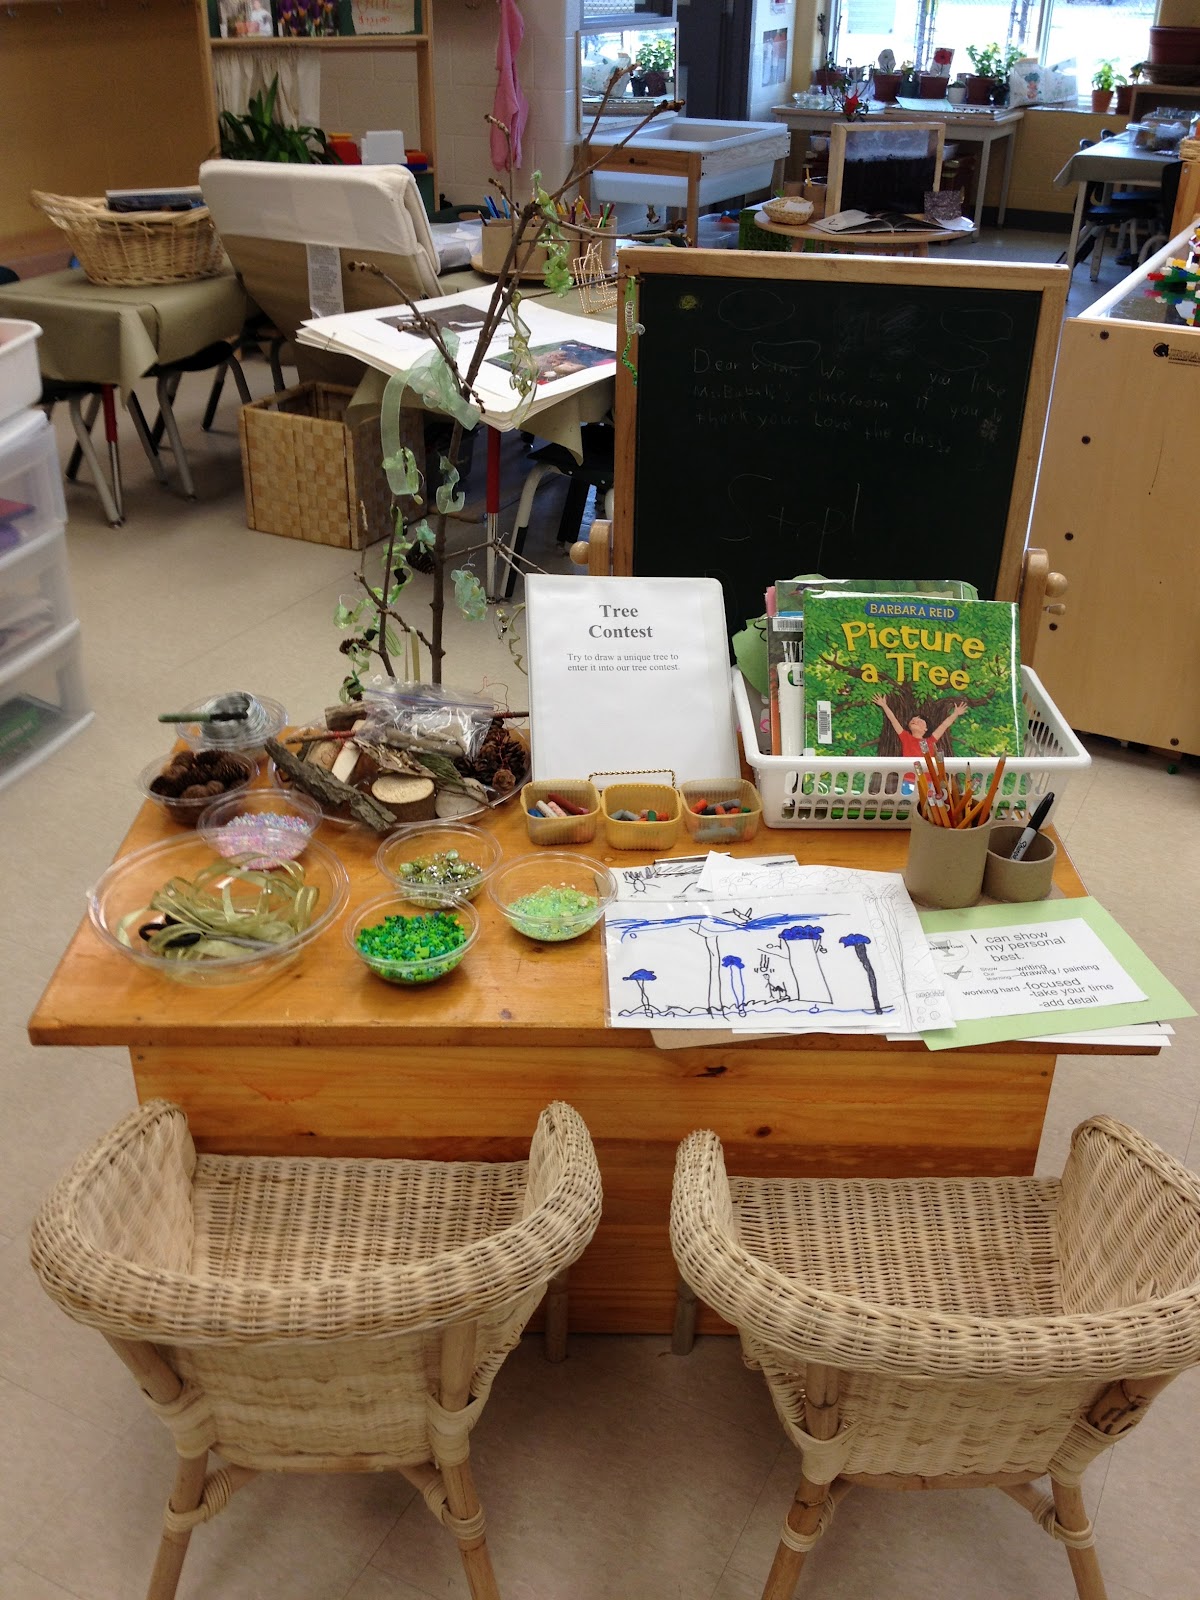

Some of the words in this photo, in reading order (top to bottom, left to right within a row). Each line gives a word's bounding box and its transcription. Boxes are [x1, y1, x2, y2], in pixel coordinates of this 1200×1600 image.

[693, 348, 740, 373] Dear
[808, 387, 889, 409] classroom
[950, 406, 980, 421] you
[864, 416, 891, 440] the
[598, 604, 639, 618] Tree
[869, 602, 926, 617] BARBARA
[929, 605, 955, 619] REID
[588, 624, 653, 639] Contest
[840, 620, 985, 660] Picture
[566, 653, 583, 663] Try
[584, 653, 593, 661] to
[594, 653, 615, 661] draw
[624, 653, 651, 663] unique
[653, 653, 669, 661] tree
[670, 653, 679, 661] to
[567, 664, 588, 672] enter
[590, 664, 597, 672] it
[598, 664, 615, 672] into
[649, 663, 681, 672] contest.
[860, 662, 879, 684] a
[885, 652, 971, 692] Tree
[970, 934, 978, 945] I
[985, 935, 1011, 944] can
[1013, 932, 1048, 941] show
[984, 943, 1004, 953] my
[1008, 936, 1067, 951] personal
[990, 952, 1025, 962] best.
[1016, 964, 1048, 972] writing
[1019, 968, 1057, 978] drawing
[1063, 963, 1100, 975] painting
[962, 987, 1000, 997] working
[999, 985, 1021, 993] hard
[1062, 987, 1085, 996] your
[1087, 983, 1115, 992] time
[1067, 995, 1099, 1006] detail
